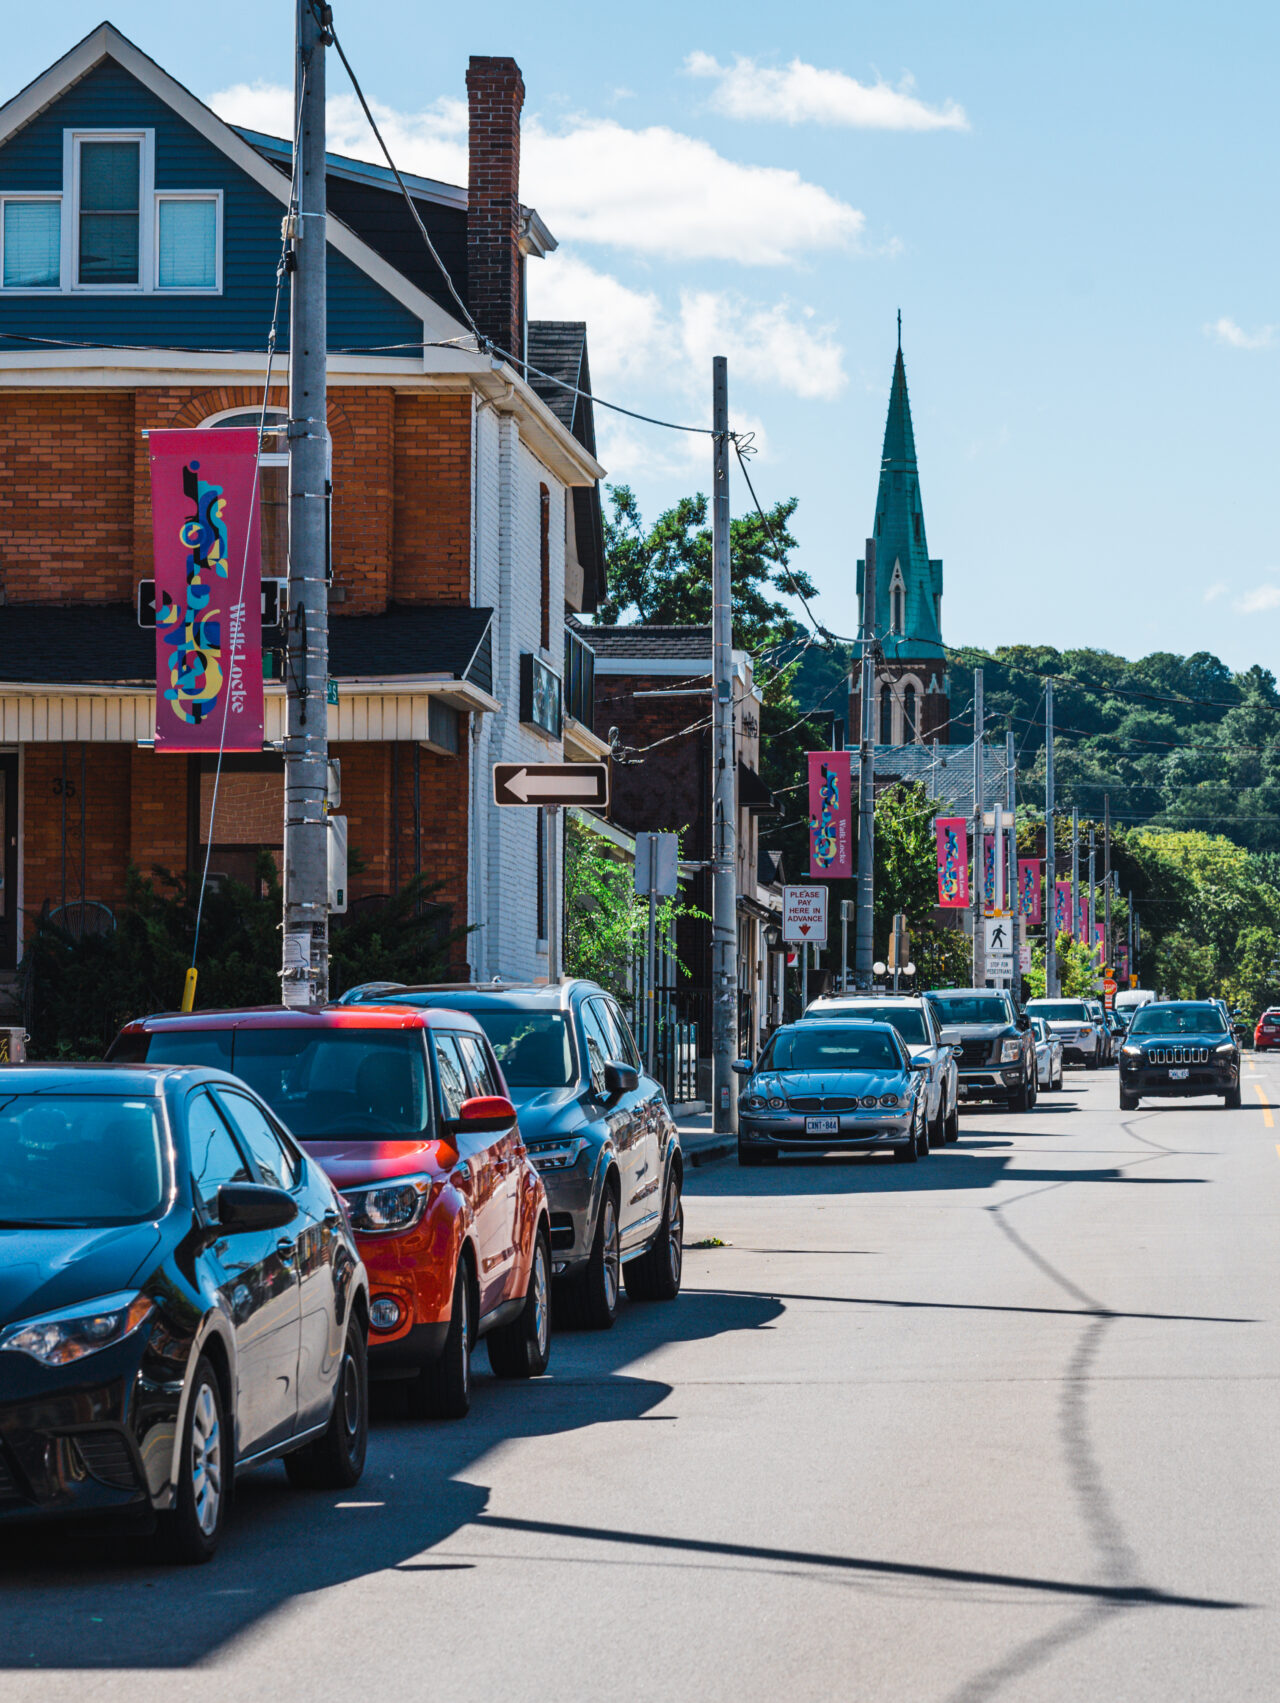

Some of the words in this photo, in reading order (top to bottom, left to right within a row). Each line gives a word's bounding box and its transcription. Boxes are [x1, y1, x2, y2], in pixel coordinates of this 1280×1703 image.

[229, 603, 246, 650] Walk
[230, 655, 247, 714] Locke
[53, 777, 76, 798] 35
